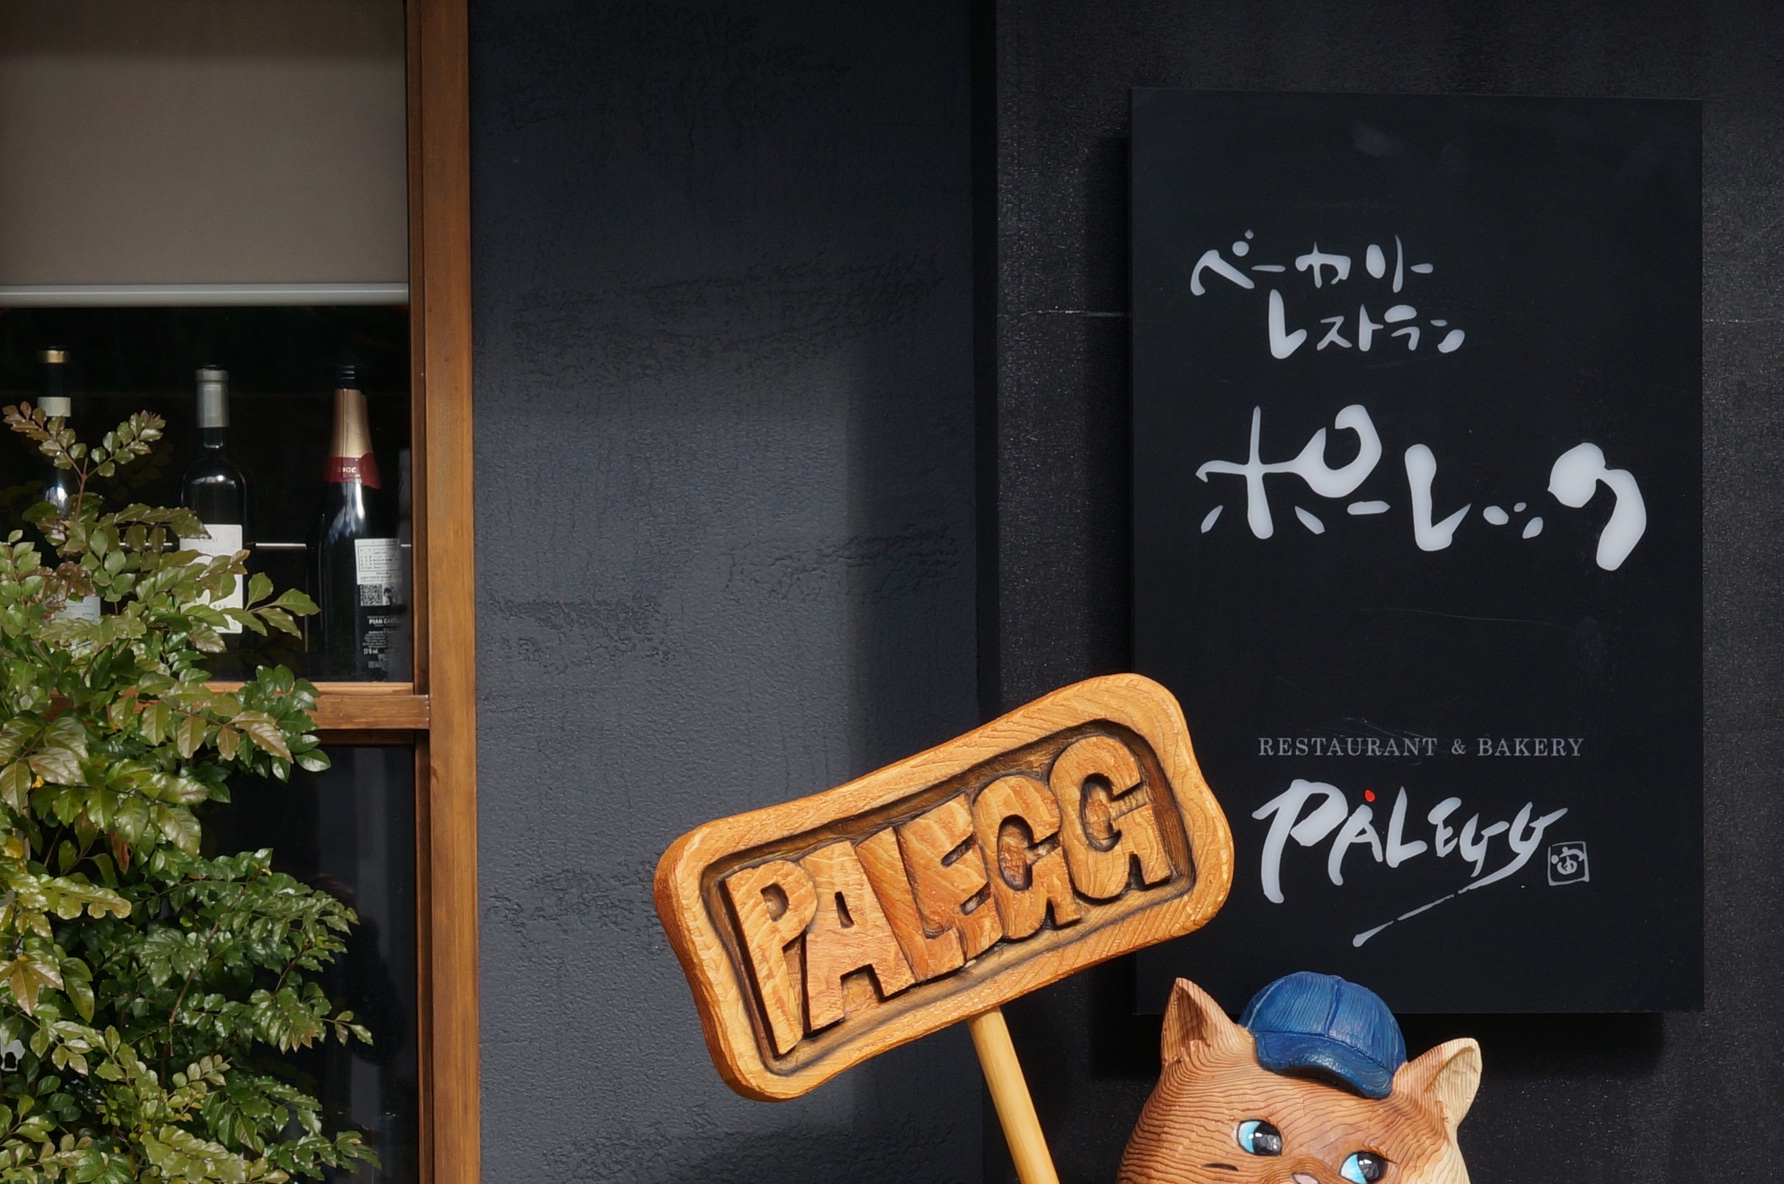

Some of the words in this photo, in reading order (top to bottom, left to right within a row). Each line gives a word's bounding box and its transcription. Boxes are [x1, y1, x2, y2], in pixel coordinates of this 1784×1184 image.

[1190, 229, 1434, 297] ベーカリー
[1268, 288, 1466, 360] レストラン
[1258, 737, 1438, 757] RESTAURANT
[1451, 737, 1467, 756] &
[1477, 737, 1584, 757] BAKERY
[718, 735, 1173, 1057] PALEGG
